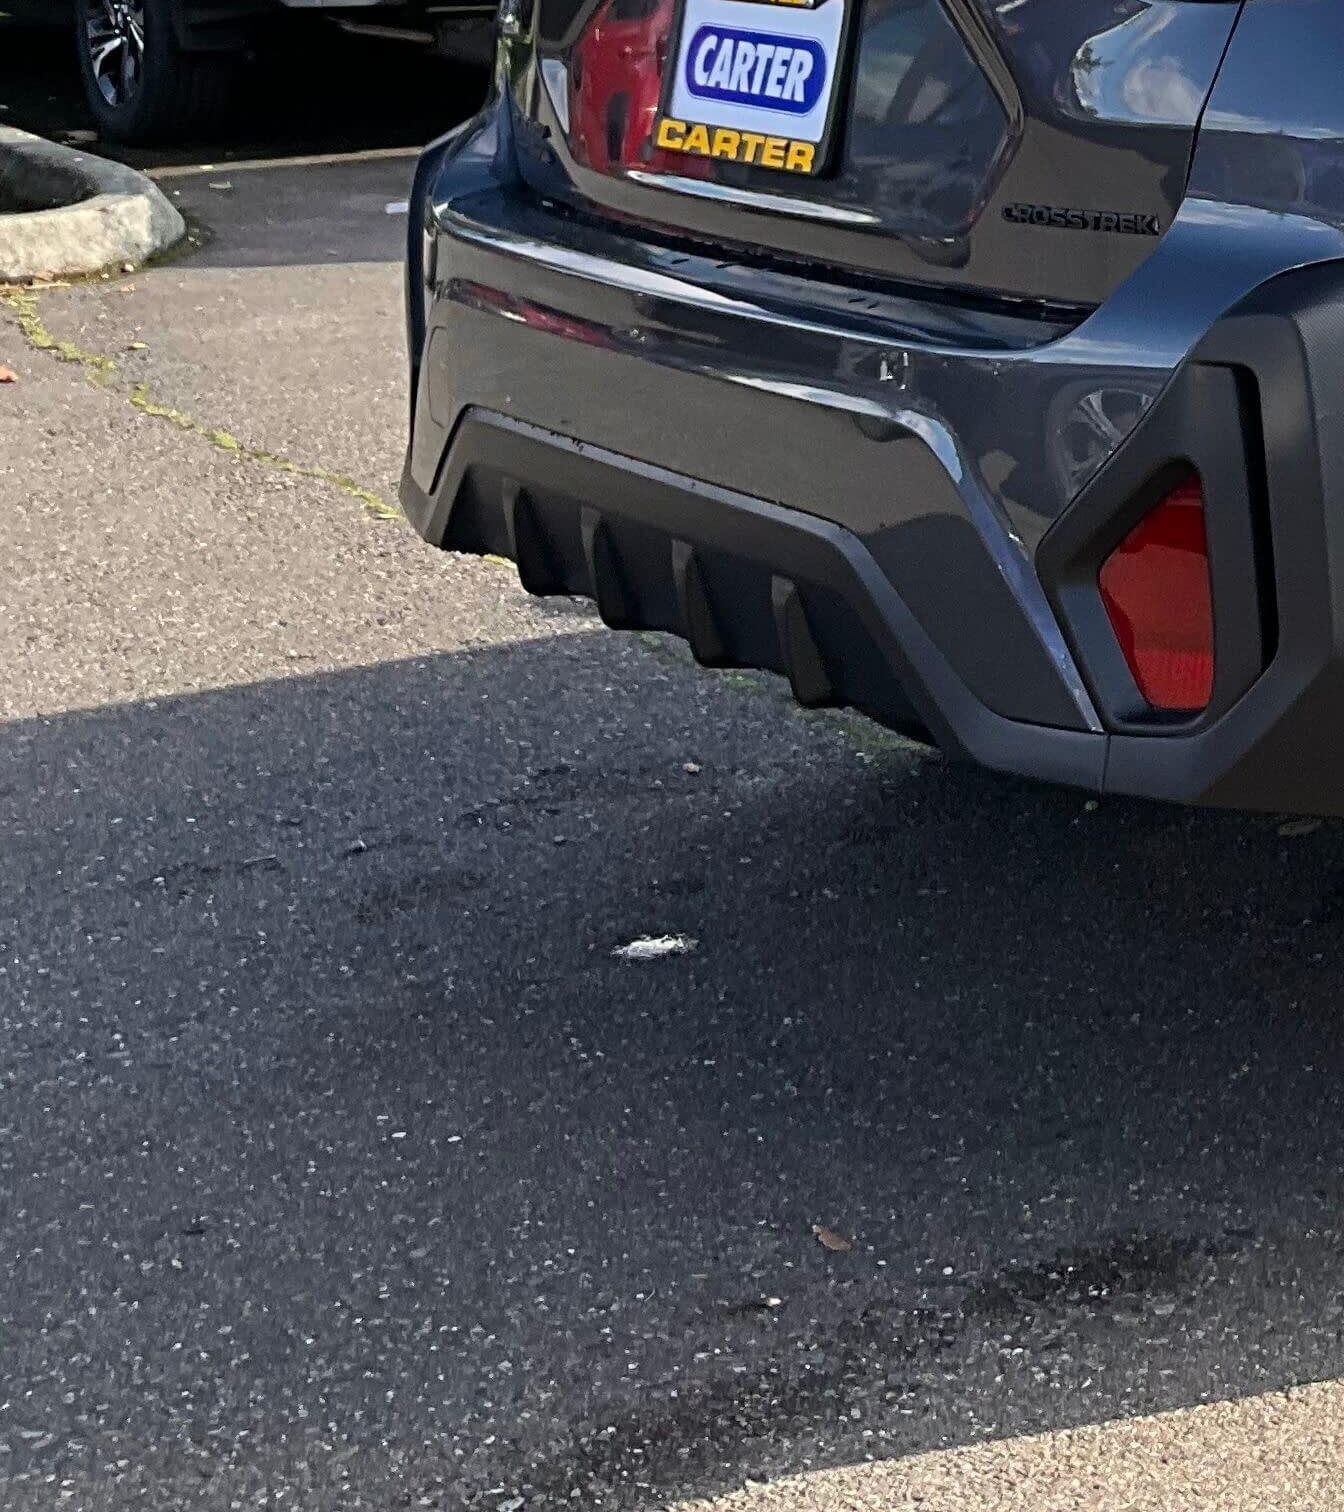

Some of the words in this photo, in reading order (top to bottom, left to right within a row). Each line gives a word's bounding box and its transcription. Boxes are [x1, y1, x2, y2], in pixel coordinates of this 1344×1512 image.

[694, 35, 813, 103] CARTER
[656, 118, 816, 173] CARTER
[1001, 202, 1160, 236] CROSSTREK
